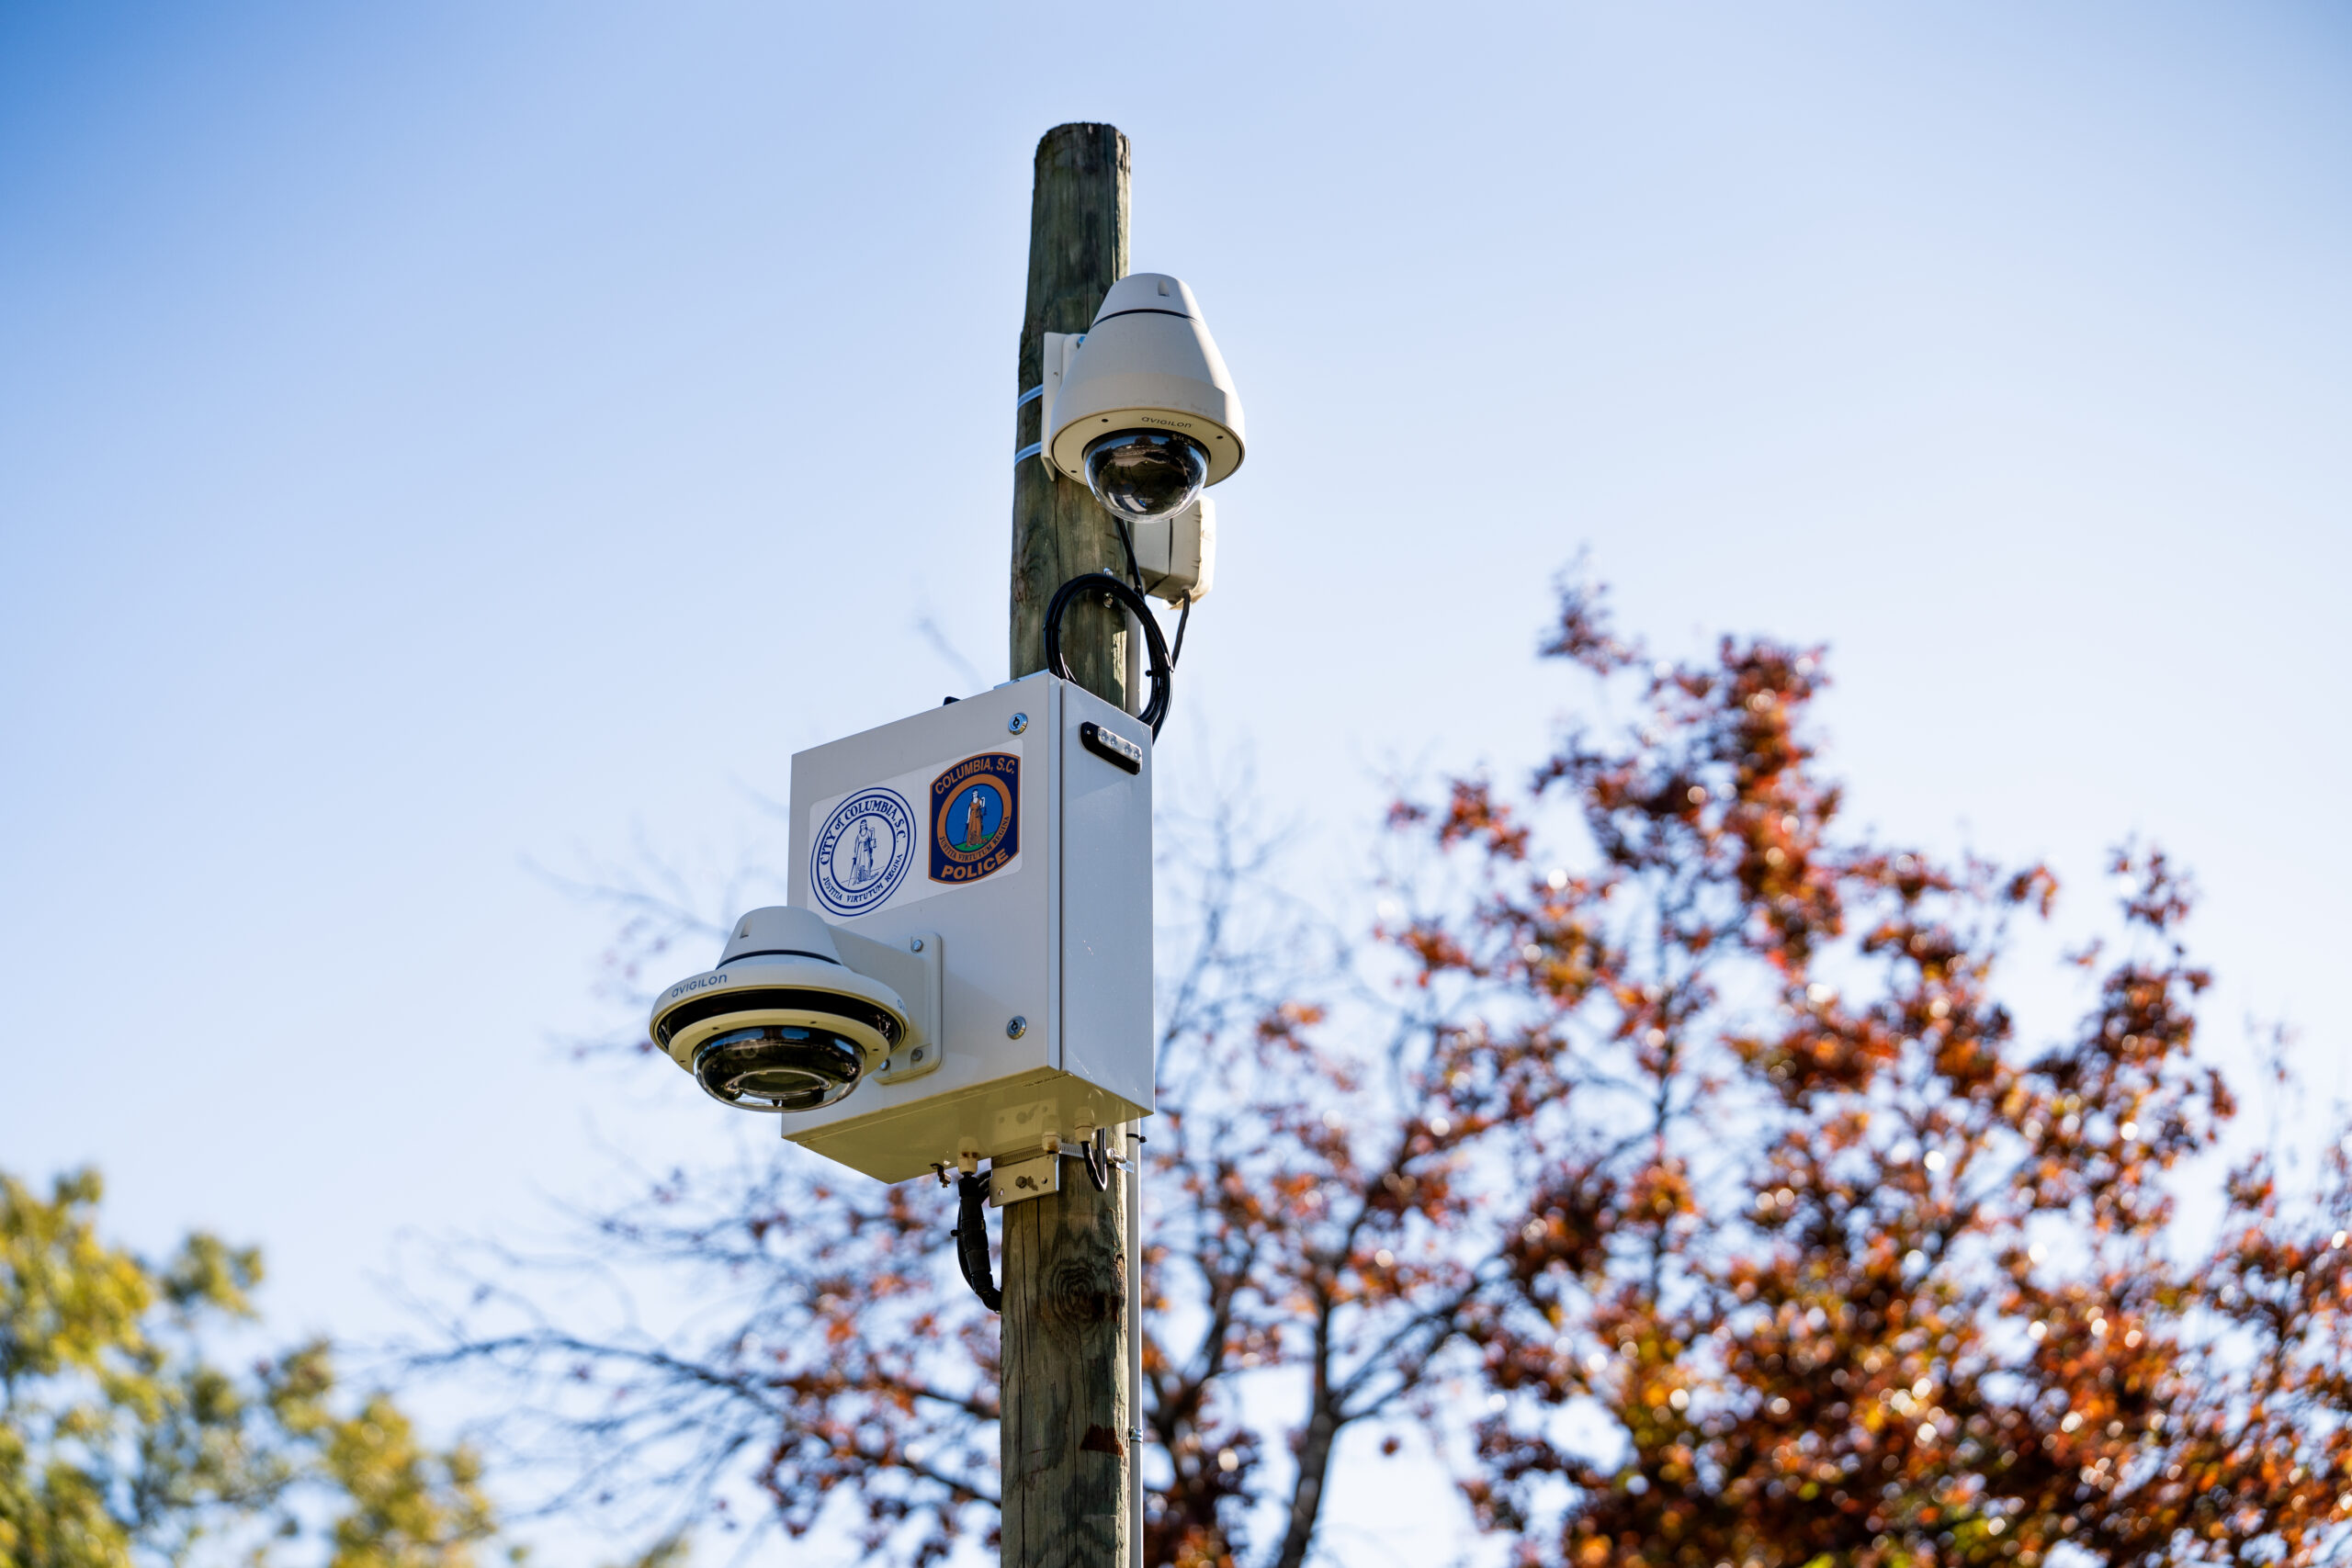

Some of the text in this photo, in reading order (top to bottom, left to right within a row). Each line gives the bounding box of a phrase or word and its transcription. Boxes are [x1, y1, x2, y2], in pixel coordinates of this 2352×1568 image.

[934, 757, 1015, 795] COLUMBIA, S.C.
[820, 800, 906, 865] CITY of COLUMBIA, S.C.
[939, 835, 956, 859] JUSTITIA
[992, 816, 1010, 846] REGINA
[822, 853, 903, 903] JUSTITIA VIRTUTUM REGINA
[940, 848, 1009, 880] POLICE
